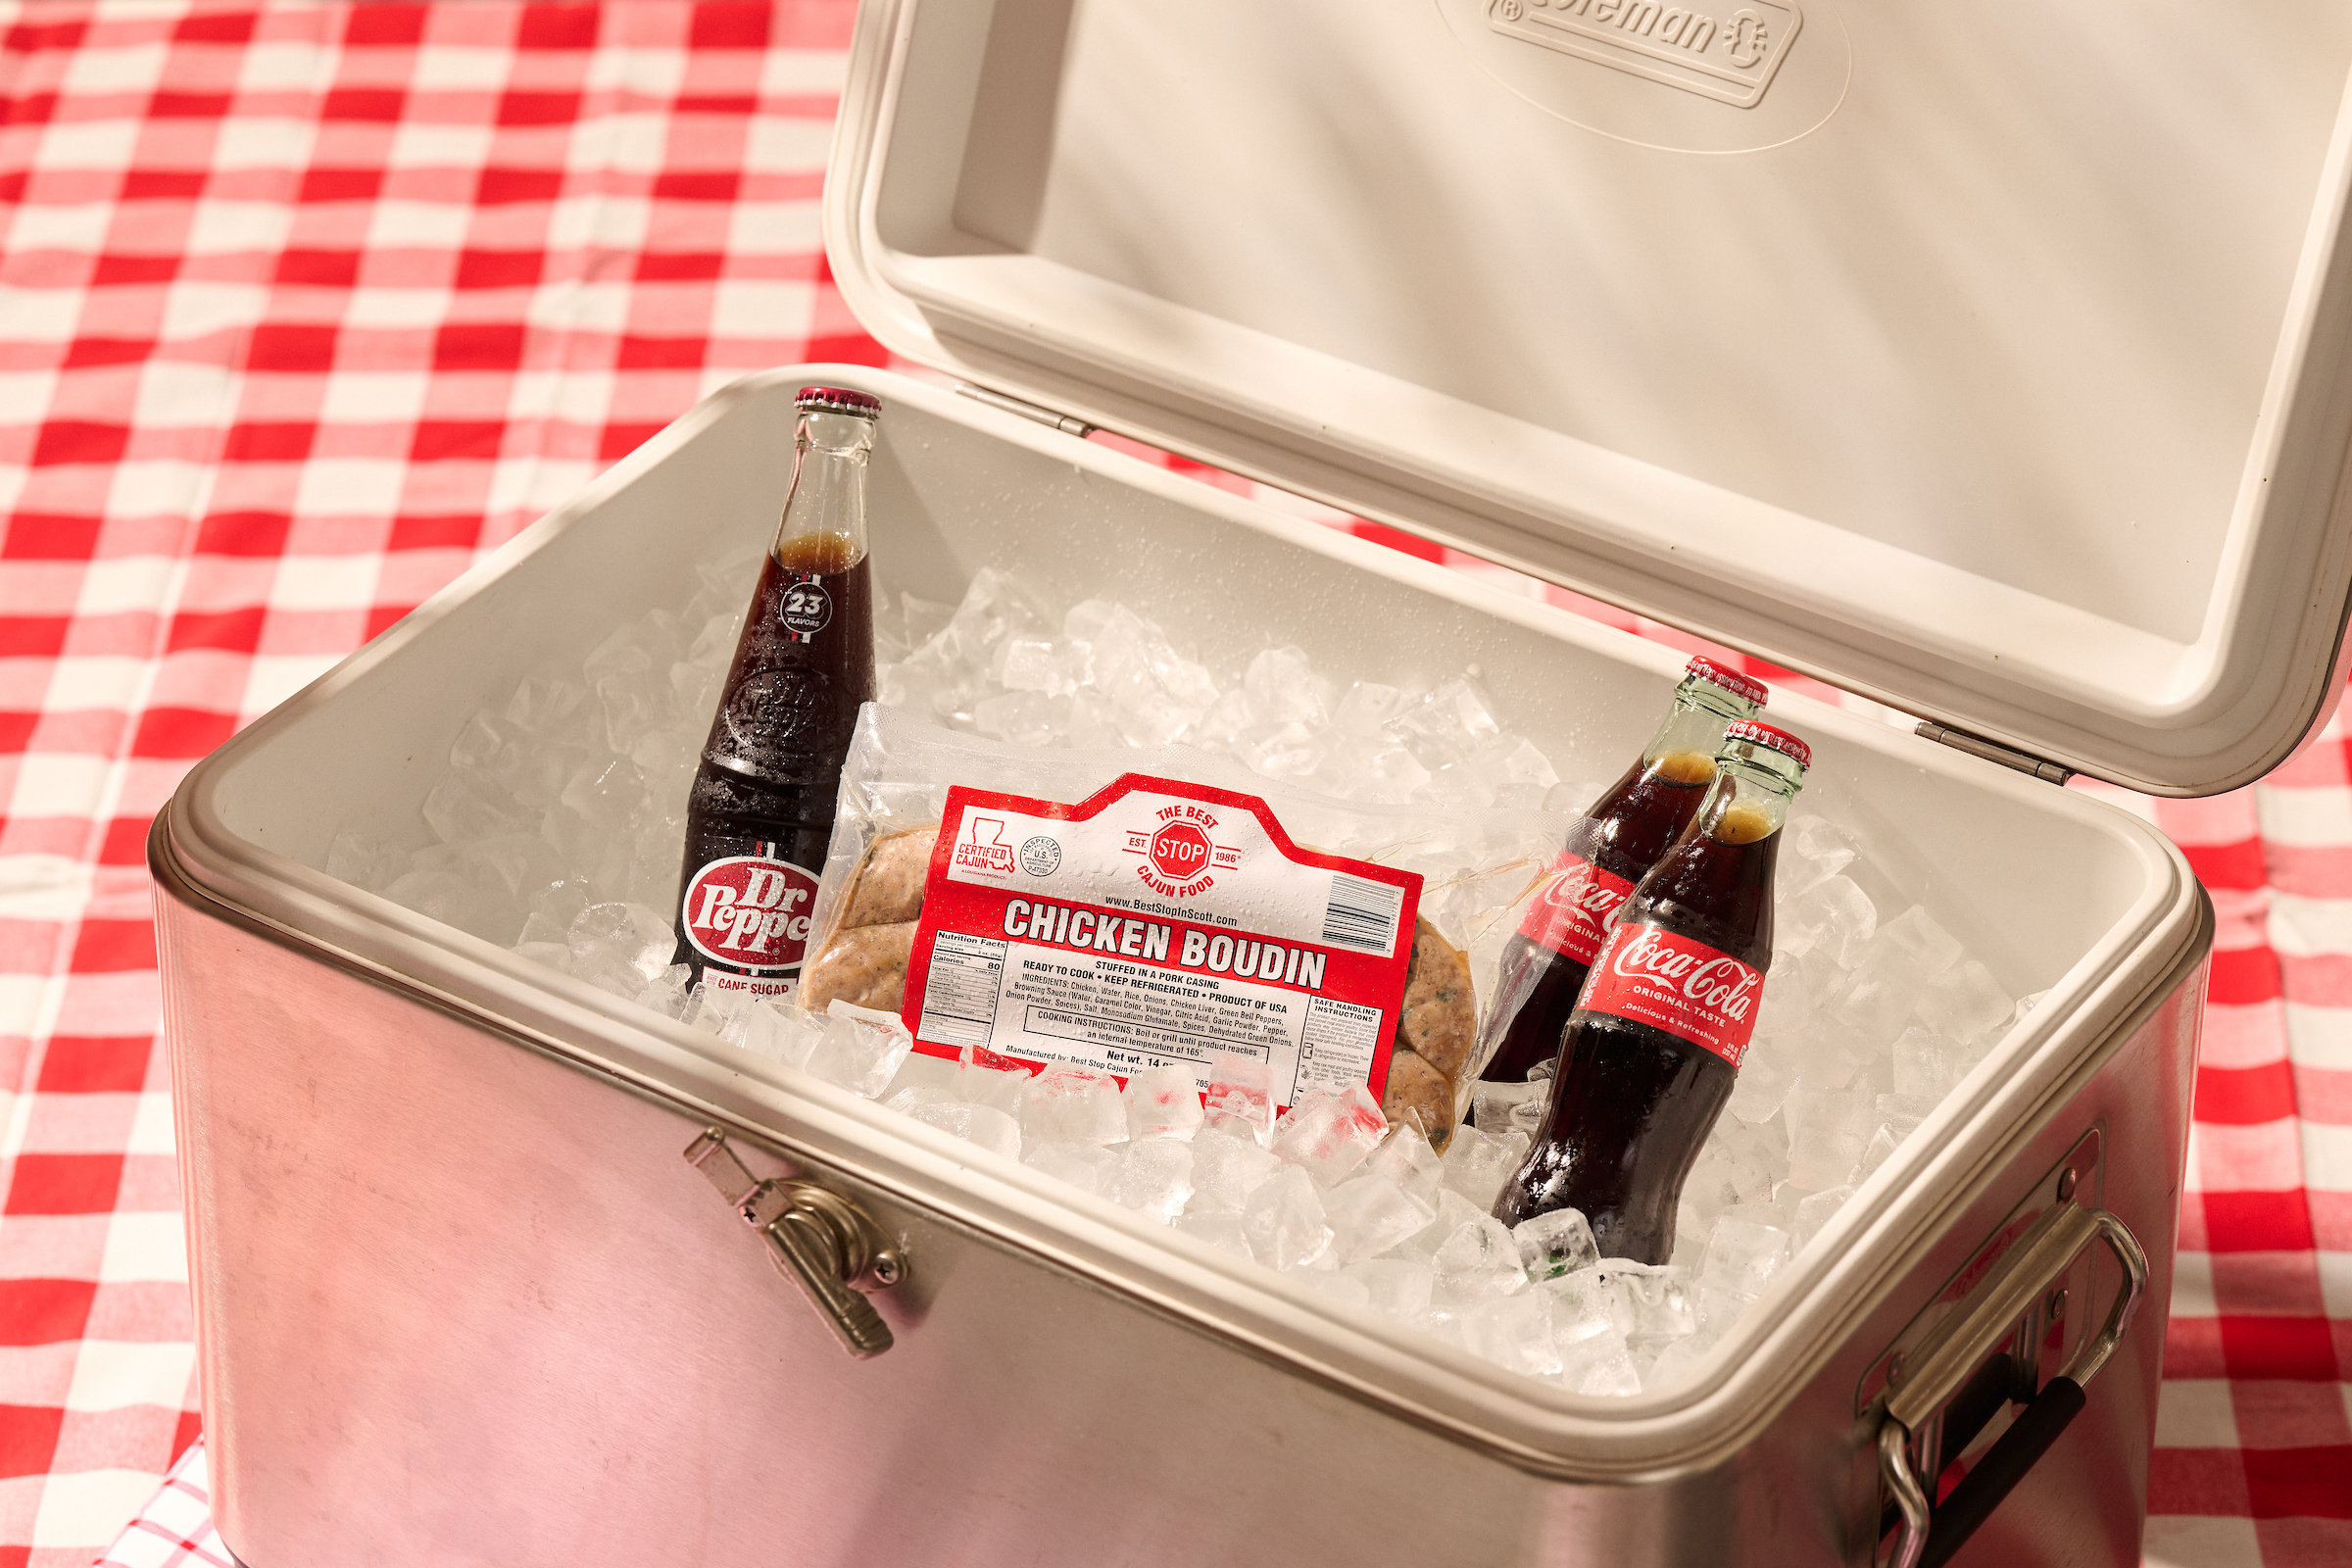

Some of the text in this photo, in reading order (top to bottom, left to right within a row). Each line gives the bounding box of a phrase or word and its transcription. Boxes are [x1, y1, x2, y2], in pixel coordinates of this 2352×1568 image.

[785, 592, 826, 617] 23
[787, 616, 820, 627] FLAVORS
[1156, 805, 1219, 829] THE BEST
[956, 854, 989, 868] CAJUN
[958, 843, 1007, 860] CERTIFIED
[1024, 838, 1059, 858] INSPECTED
[1034, 851, 1048, 859] U.S.
[1128, 837, 1147, 849] EST.
[1156, 838, 1204, 862] STOP
[734, 866, 808, 912] Dr
[1137, 864, 1214, 898] CAJUN FOOD
[692, 883, 812, 954] Peppe
[1103, 896, 1238, 927] www.BestStopInScott.com
[938, 931, 978, 944] Nutrition
[980, 939, 1005, 949] Facts
[1003, 898, 1327, 990] CHICKEN BOUDIN
[933, 955, 964, 964] Calories
[717, 978, 748, 991] CANE
[1023, 959, 1287, 1014] READY TO COOK KEEP REFRIGERATED PRODUCT OF USA
[1095, 960, 1219, 990] STUFFED IN A PORK CASING
[1613, 930, 1761, 1022] Coca-Cola
[1014, 981, 1289, 1037] Browning Sauce (Water, Caramel Color, Vinegar, Citric Acid, Garlic Powder, Pepper,
[1022, 973, 1284, 1026] INGREDIENTS: Chicken, Water, Rice, Onions, Chicken Liver, Green Bell Peppers,
[1314, 998, 1377, 1016] SAFE HANDLING
[1633, 985, 1726, 1028] ORIGINAL TASTE
[1005, 990, 1294, 1048] Onion Powder, Spices), Salt, Monosodium Glutamate, Spices, Dehydrated Green Onions.
[1314, 1005, 1373, 1023] INSTRUCTIONS
[1626, 1003, 1666, 1021] Delicious
[1677, 1019, 1720, 1046] Refreshing
[1038, 1010, 1073, 1024] COOKING
[1074, 1017, 1134, 1035] INSTRUCTIONS:
[1135, 1028, 1151, 1038] Boil
[1161, 1034, 1178, 1043] grill
[1179, 1037, 1197, 1046] until
[1198, 1041, 1226, 1051] product
[1227, 1046, 1257, 1056] reaches
[1099, 1033, 1128, 1044] internal
[1129, 1038, 1174, 1053] temperature
[1005, 1045, 1059, 1060] Manufactured
[1070, 1055, 1087, 1065] Best
[1088, 1059, 1105, 1069] Stop
[1106, 1062, 1128, 1073] Cajun
[1106, 1050, 1125, 1061] Net
[1127, 1055, 1143, 1065] wt.
[1148, 1057, 1159, 1068] 14
